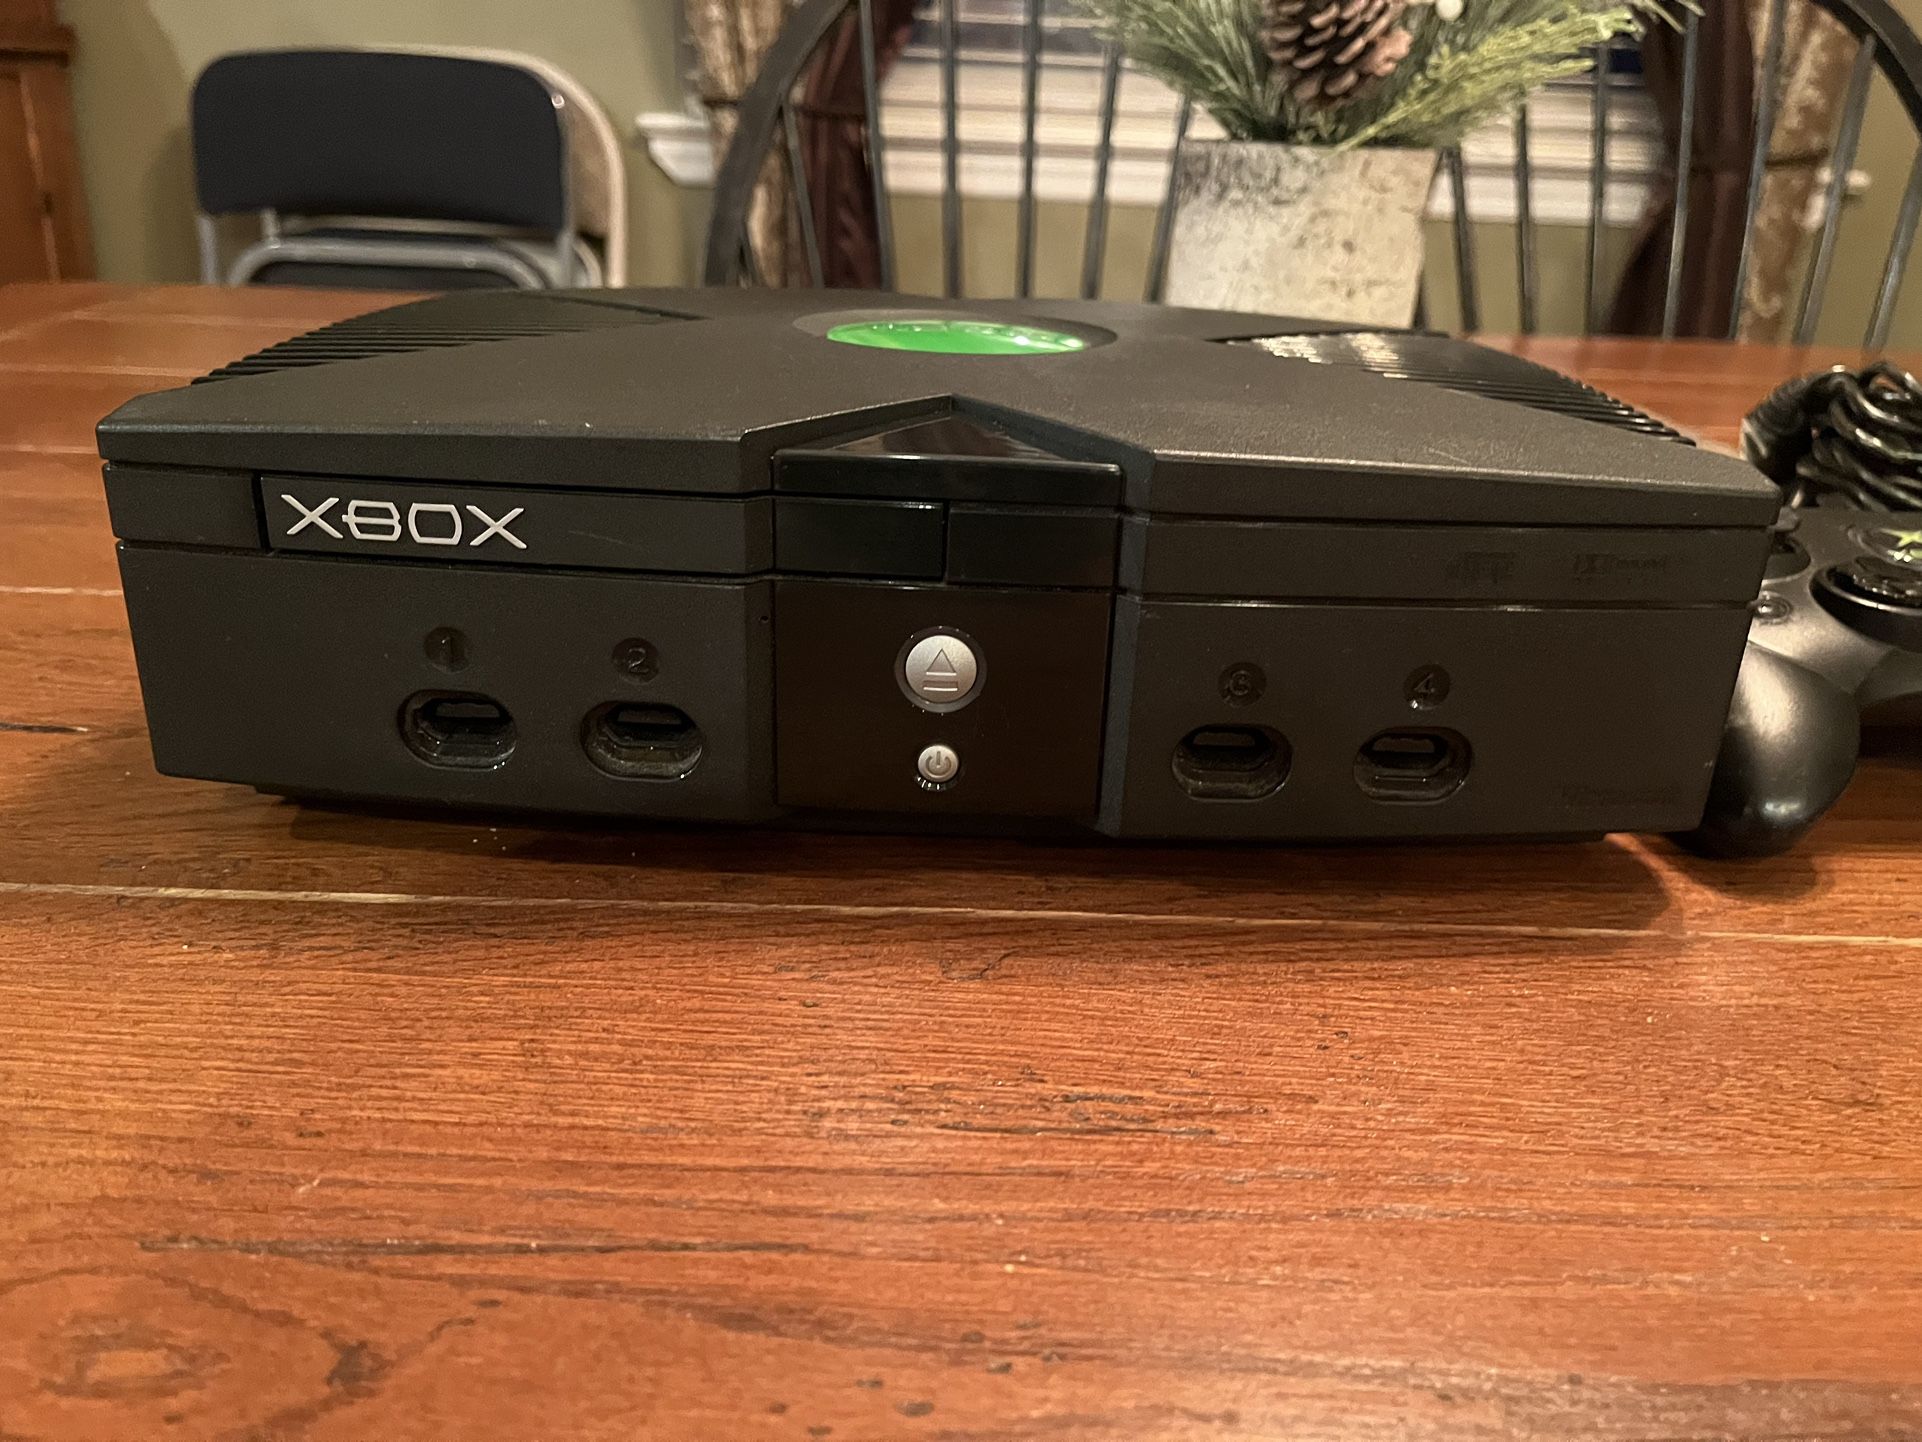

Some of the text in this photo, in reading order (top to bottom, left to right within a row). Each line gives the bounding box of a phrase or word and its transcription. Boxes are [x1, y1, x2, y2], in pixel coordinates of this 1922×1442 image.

[281, 494, 527, 549] XBOX
[627, 646, 650, 674] 2
[1412, 671, 1436, 700] 4
